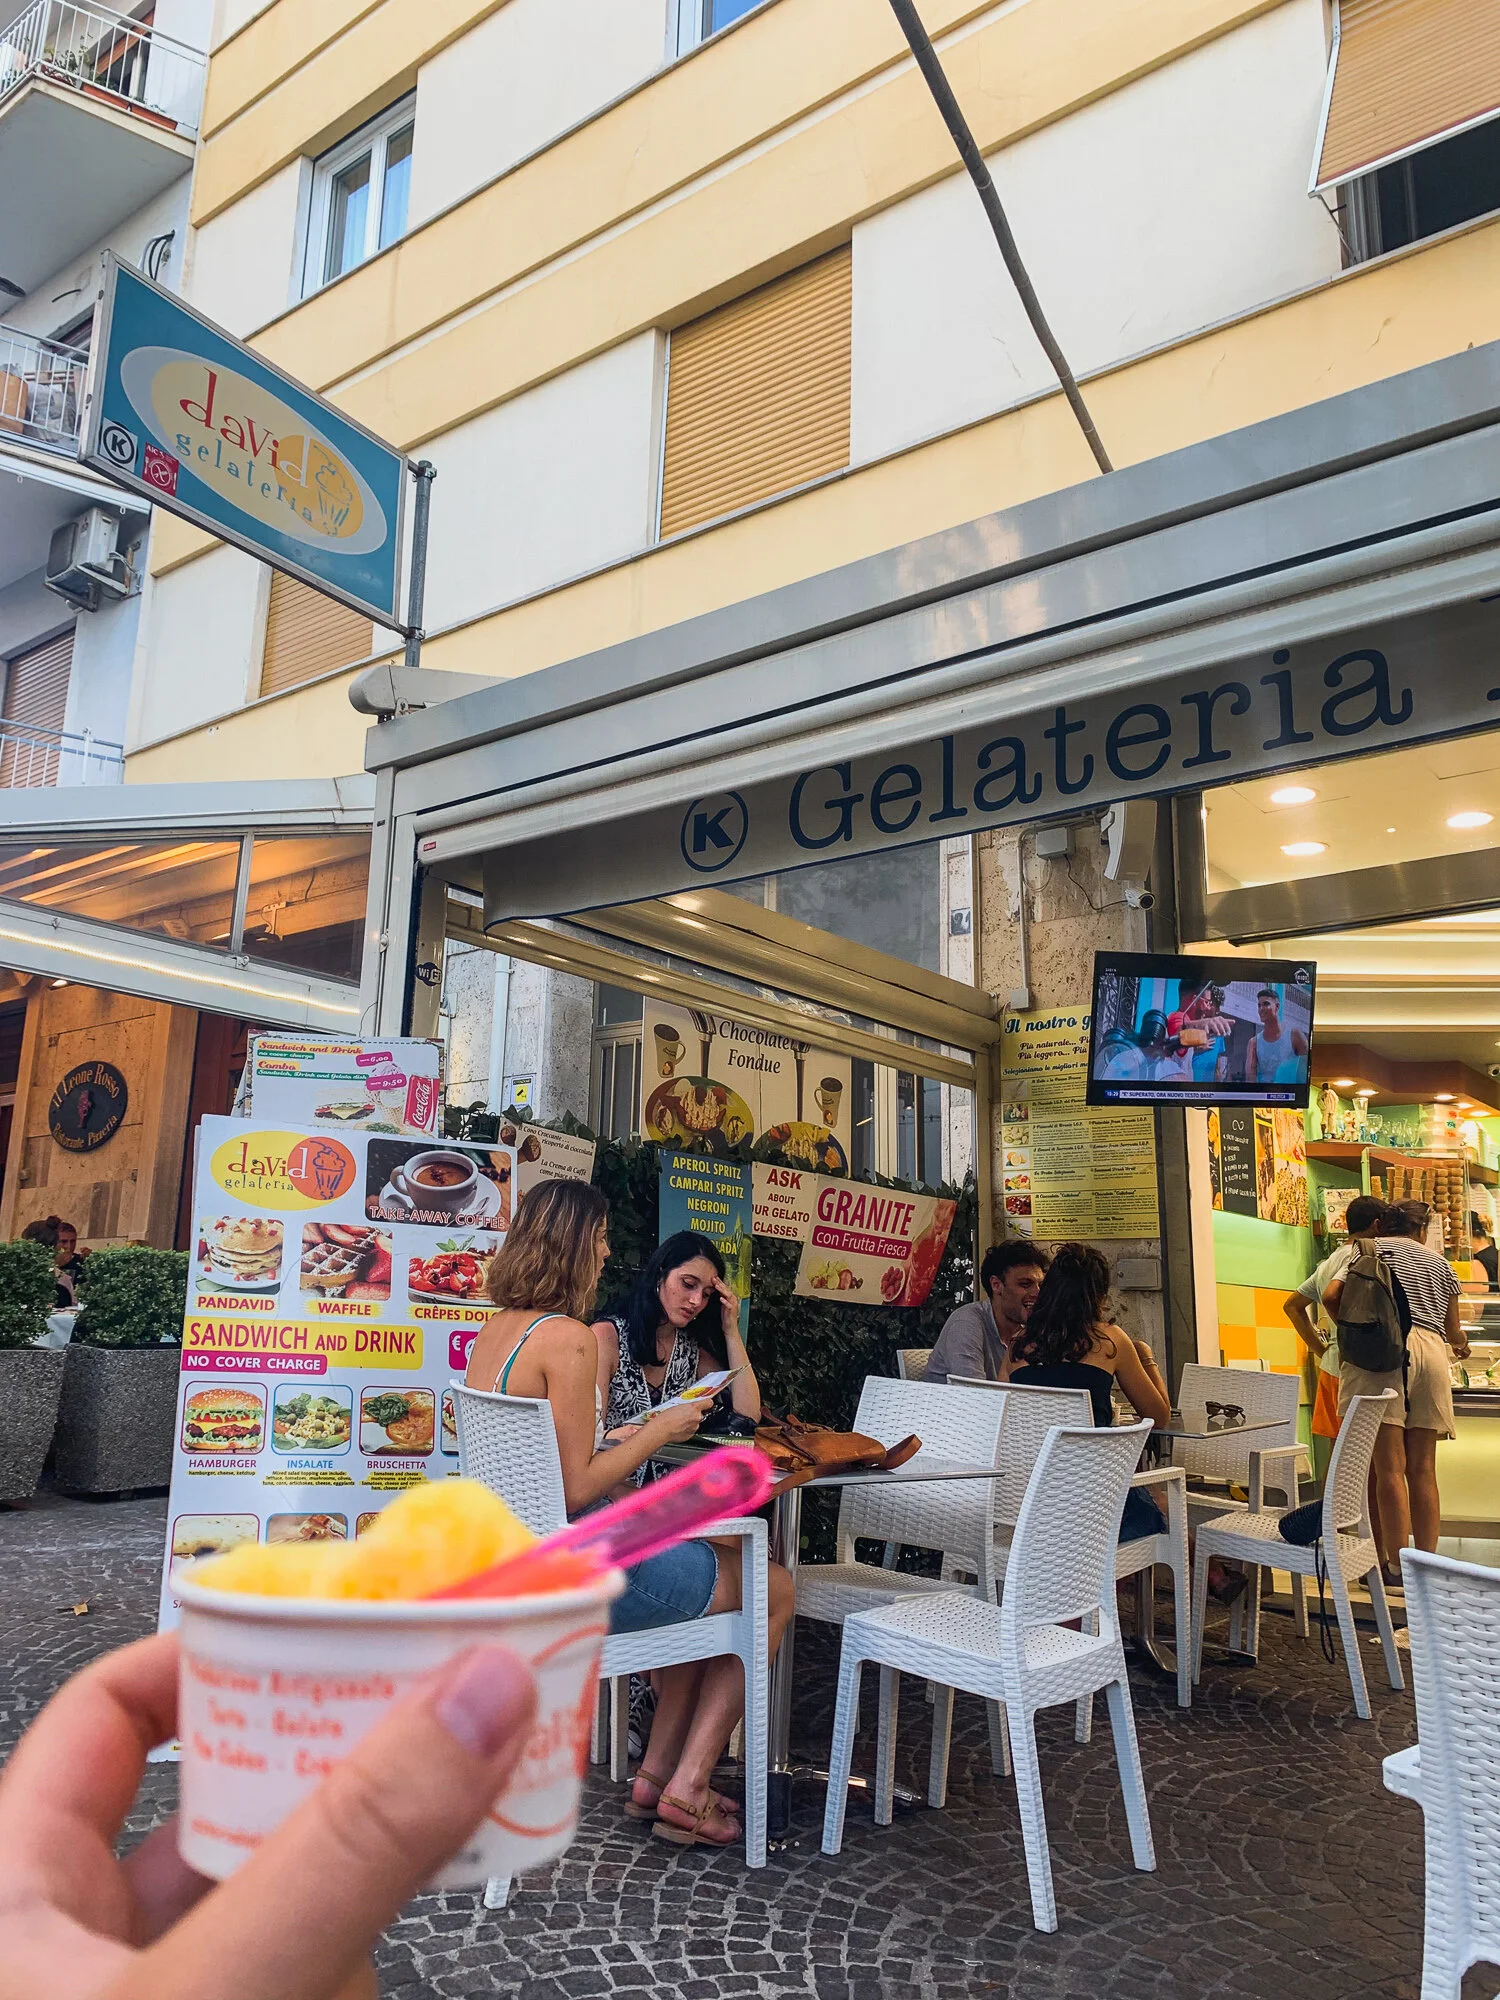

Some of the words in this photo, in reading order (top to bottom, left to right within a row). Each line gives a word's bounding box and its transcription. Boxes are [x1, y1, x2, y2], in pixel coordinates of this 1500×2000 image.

[175, 431, 313, 523] gelateria
[788, 648, 1413, 851] Gelateria
[1004, 1018, 1021, 1034] Il
[1025, 1016, 1077, 1032] nostro
[719, 1019, 792, 1051] Chocolate
[258, 1042, 307, 1052] Sandwich
[331, 1046, 362, 1054] Drink
[258, 1060, 297, 1070] Combo
[727, 1048, 781, 1074] Fondue
[61, 1068, 93, 1096] Leone
[93, 1063, 120, 1099] Rosso
[523, 1126, 537, 1135] Cono
[549, 1161, 566, 1171] Crema
[672, 1156, 711, 1174] APEROL
[713, 1163, 741, 1180] SPRITZ
[224, 1174, 294, 1191] gelateria
[669, 1175, 713, 1194] CAMPARI
[716, 1182, 744, 1199] SPRITZ
[766, 1168, 803, 1190] ASK
[687, 1197, 730, 1216] NEGRONI
[768, 1193, 795, 1205] ABOUT
[369, 1205, 451, 1224] TAKE-AWAY
[455, 1213, 506, 1229] COFFEE
[752, 1204, 769, 1217] UR
[771, 1207, 810, 1223] GELATO
[817, 1187, 915, 1236] GRANITE
[690, 1217, 726, 1234] MOJITO
[753, 1221, 798, 1237] CLASSES
[816, 1231, 839, 1246] con
[841, 1232, 875, 1253] Frutta
[876, 1240, 907, 1257] Fresca
[197, 1296, 275, 1311] PANDAVID
[318, 1302, 371, 1316] WAFFLE
[414, 1305, 461, 1321] CRÊPES
[189, 1322, 308, 1350] SANDWICH
[315, 1334, 347, 1351] AND
[354, 1329, 416, 1354] DRINK
[187, 1355, 209, 1367] NO
[215, 1355, 261, 1369] COVER
[266, 1357, 321, 1371] CHARGE
[188, 1459, 257, 1468] HAMBURGER
[287, 1460, 333, 1469] INSALATE
[367, 1460, 427, 1469] BRUSCHETTA
